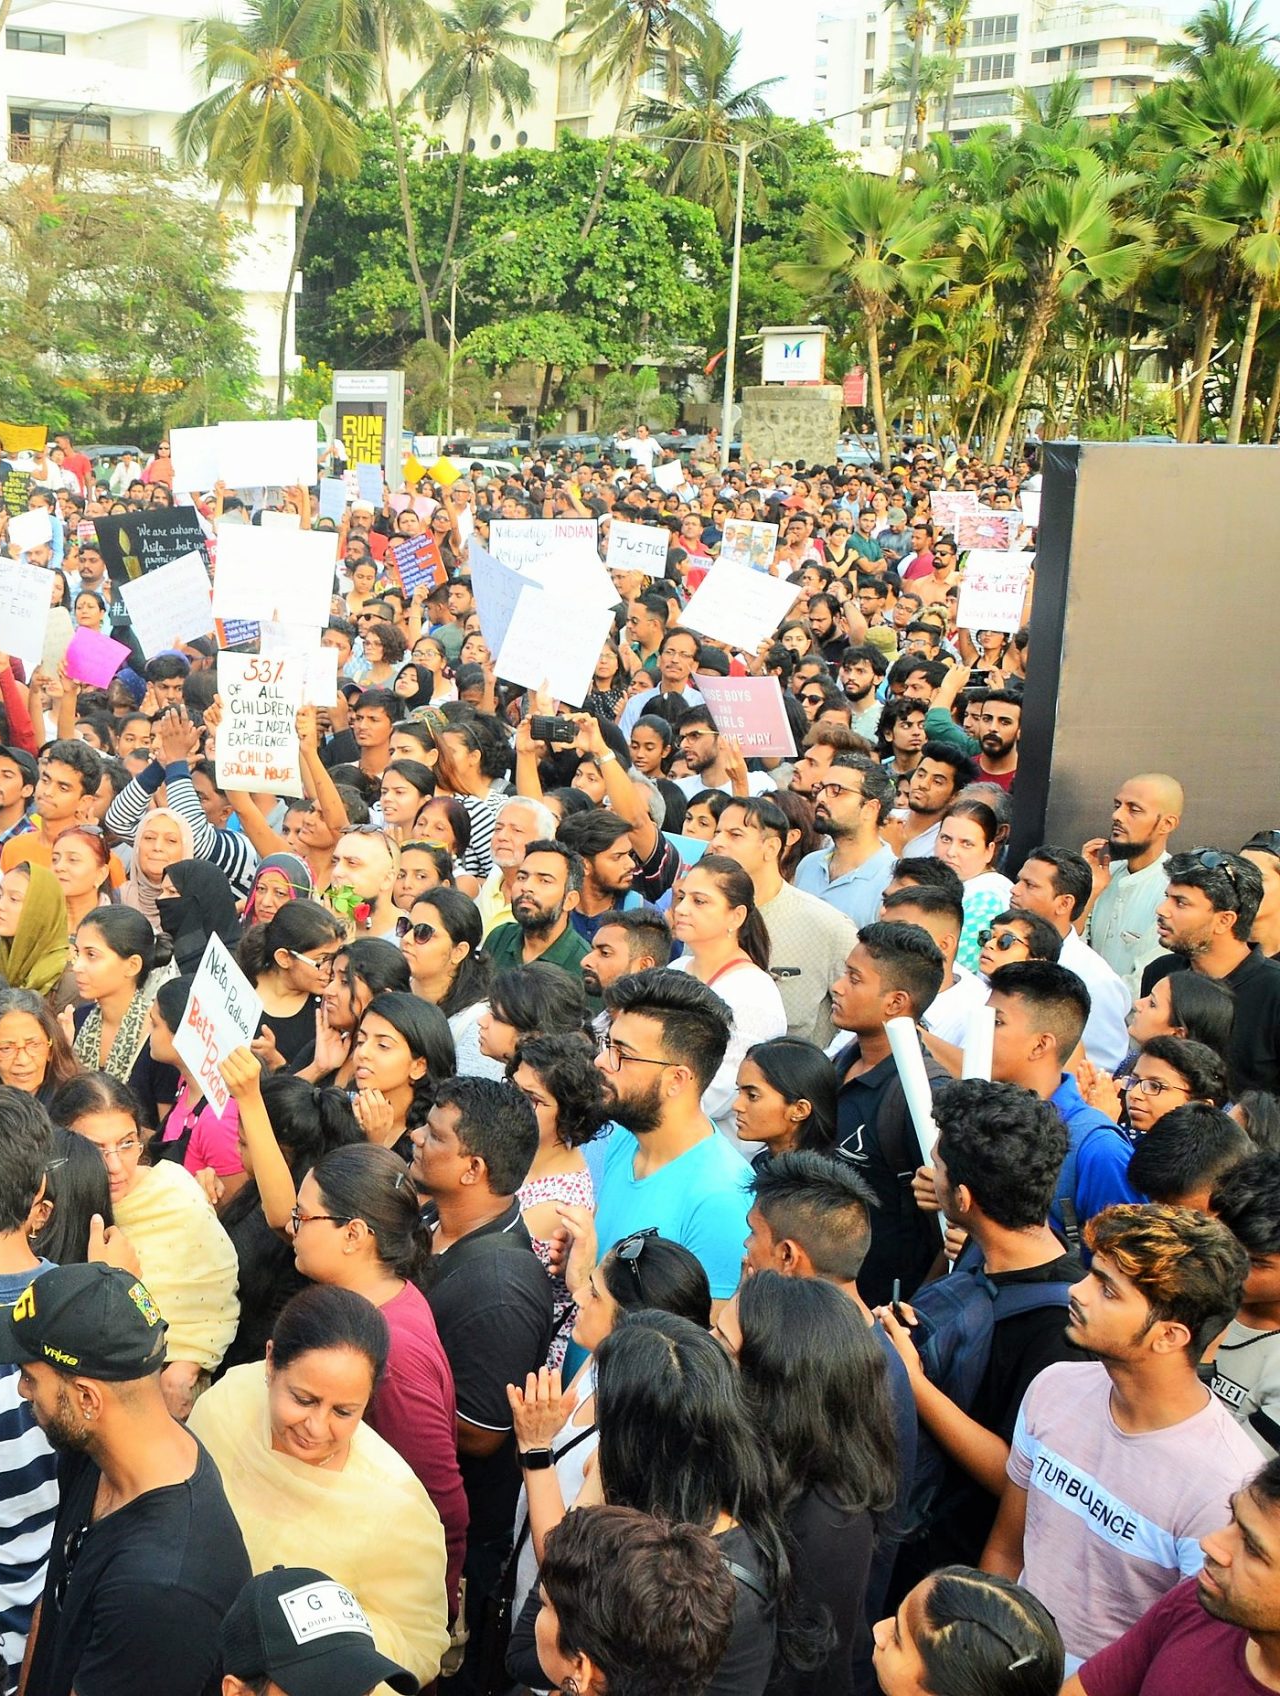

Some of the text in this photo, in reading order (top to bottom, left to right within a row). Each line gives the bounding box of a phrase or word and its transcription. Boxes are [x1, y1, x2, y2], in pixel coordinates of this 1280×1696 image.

[343, 415, 383, 441] RUN
[137, 523, 151, 537] We
[152, 528, 168, 537] are
[554, 524, 594, 539] INDIAN
[616, 536, 666, 557] JUSTICE
[243, 659, 285, 684] 53%
[227, 684, 285, 699] OF ALL
[724, 689, 752, 702] BOYS
[230, 699, 295, 718] CHILDREN
[232, 719, 291, 735] IN INDIA
[228, 732, 289, 747] EXPERIENCE
[238, 750, 274, 764] CHILD
[222, 762, 296, 781] SEXUAL ABUSE
[206, 947, 228, 993] Neta
[188, 996, 216, 1048] Beti
[307, 1594, 323, 1611] G
